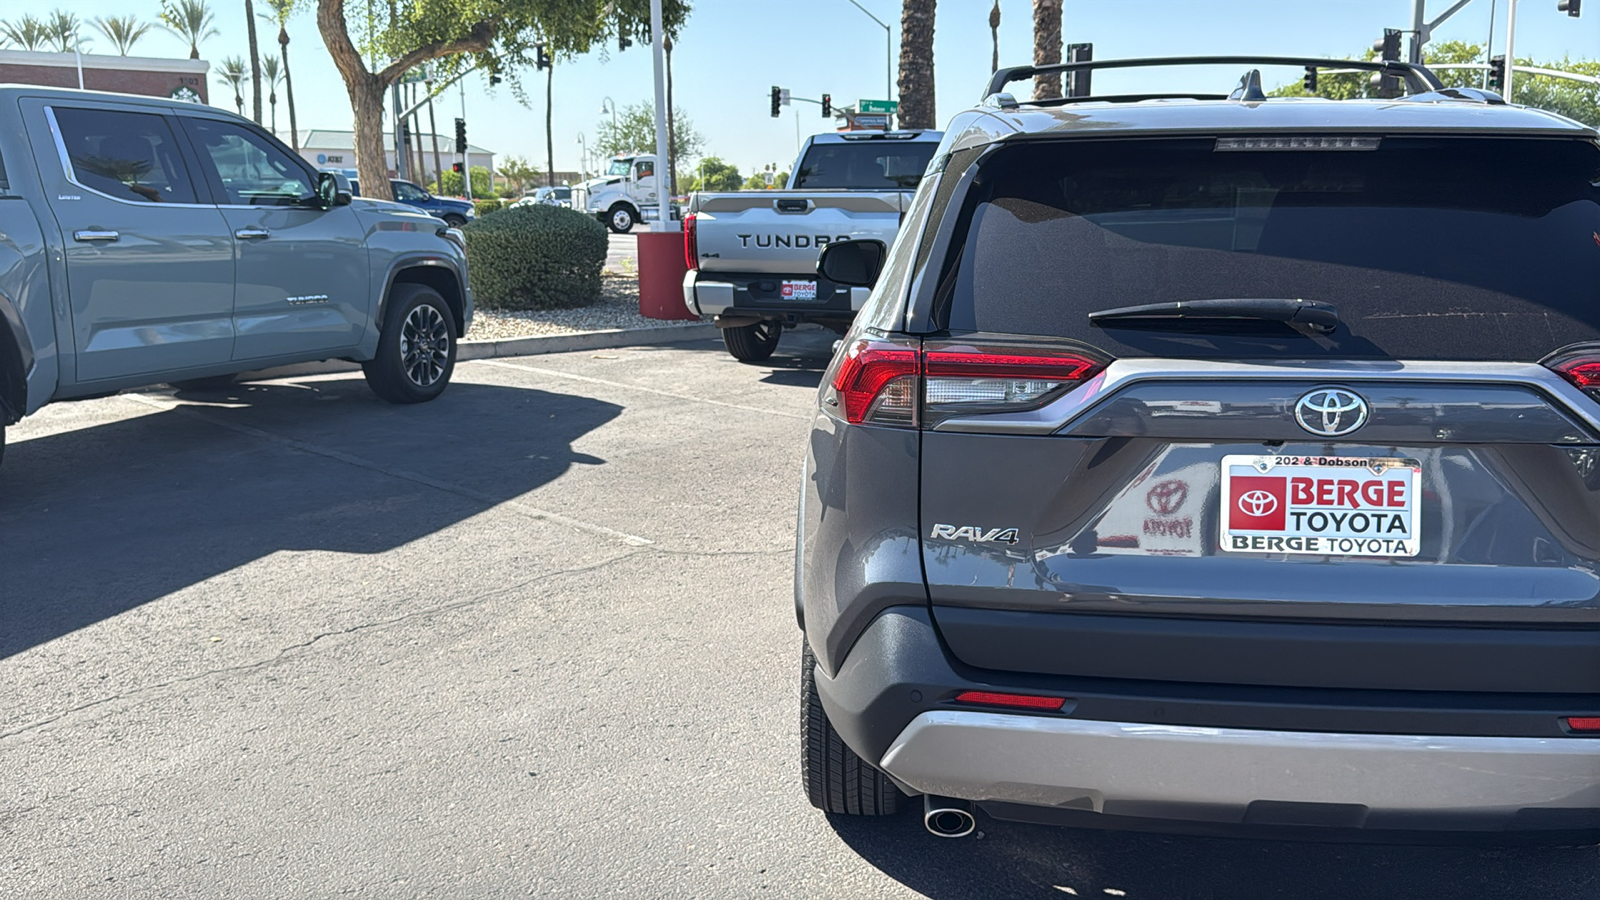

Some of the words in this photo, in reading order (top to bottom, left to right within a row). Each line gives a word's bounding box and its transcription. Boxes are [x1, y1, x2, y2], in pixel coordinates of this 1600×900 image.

[1275, 456, 1299, 465] 202
[1303, 457, 1313, 465] &
[1318, 457, 1368, 467] Dobson
[1290, 477, 1406, 509] BERGE
[1290, 511, 1407, 534] TOYOTA
[930, 523, 1019, 545] RAV4
[1232, 535, 1320, 552] BERGE
[1324, 538, 1408, 554] TOYOTA
